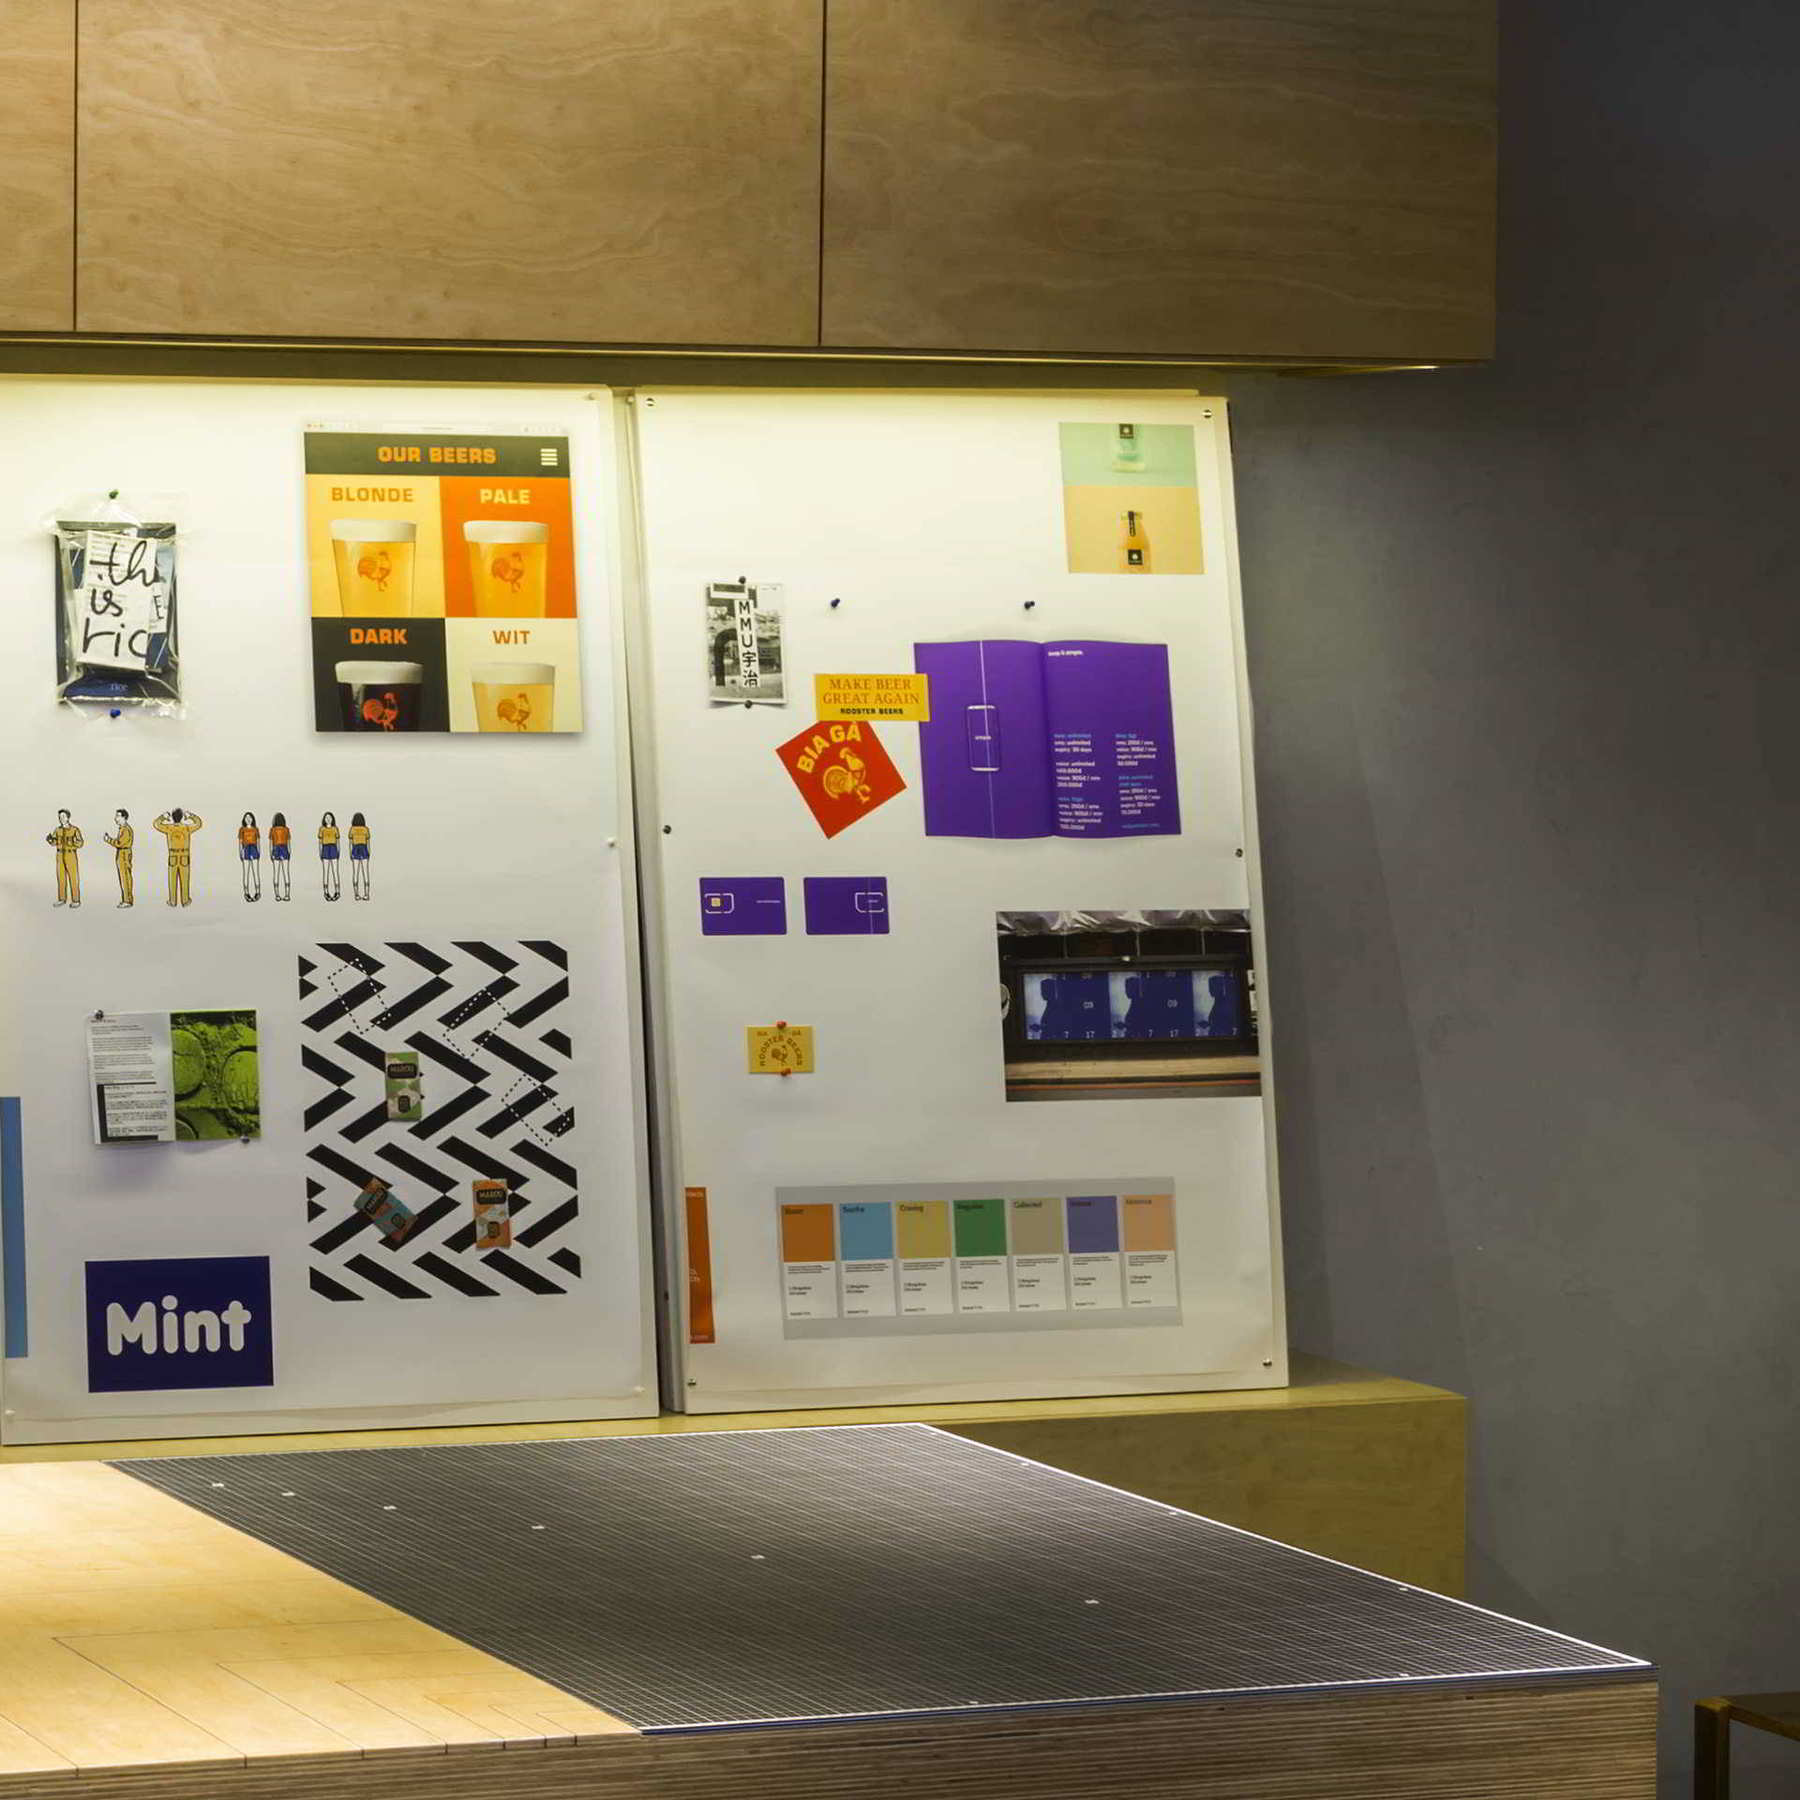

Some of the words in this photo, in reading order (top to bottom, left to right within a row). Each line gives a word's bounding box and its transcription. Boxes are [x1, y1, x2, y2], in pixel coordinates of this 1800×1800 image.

[377, 446, 421, 463] OUR
[428, 447, 496, 464] BEERS
[331, 487, 414, 502] BLONDE
[479, 489, 530, 504] PALE
[350, 628, 408, 645] DARK
[493, 630, 530, 645] WIT
[830, 679, 872, 690] MAKE
[876, 679, 911, 690] BEER
[823, 693, 871, 704] GREAT
[876, 693, 919, 704] AGAIN
[796, 734, 830, 773] BIA
[106, 1295, 252, 1356] Mint
